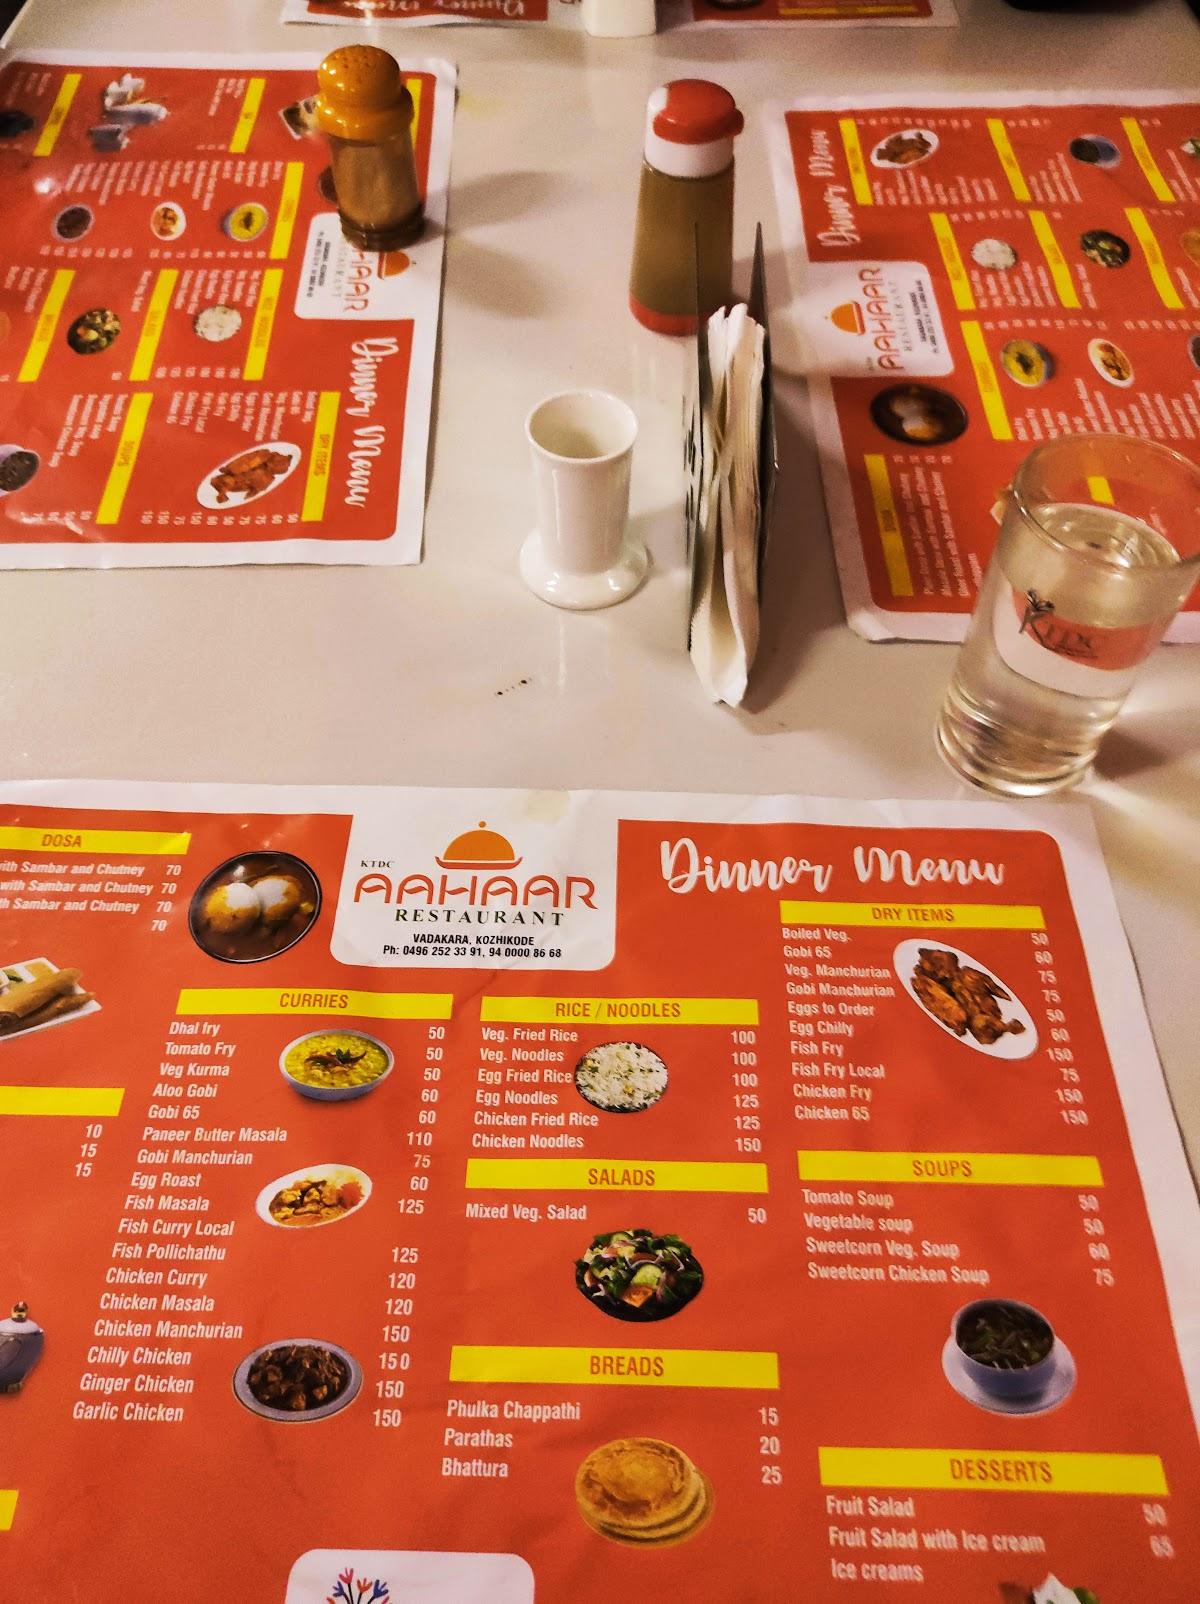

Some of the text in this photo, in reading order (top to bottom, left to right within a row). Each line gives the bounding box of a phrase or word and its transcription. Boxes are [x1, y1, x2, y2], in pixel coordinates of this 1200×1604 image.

[859, 267, 904, 370] AAHAAR
[344, 337, 399, 508] Dinner Menu
[42, 834, 81, 847] DOSA
[21, 862, 181, 877] Sambar and Chutney 70
[360, 860, 395, 868] KTDC
[661, 838, 1003, 893] Dinner Menu
[354, 874, 598, 909] AAHAAR
[396, 909, 564, 925] RESTAURANT
[872, 908, 954, 922] DRY ITEMS
[476, 935, 534, 946] KOZHIKODE
[782, 928, 850, 942] Boiled Veg.
[403, 946, 427, 956] 0496
[432, 947, 449, 956] 252
[454, 947, 466, 957] 33
[489, 948, 501, 957] 94
[505, 948, 530, 958] 0000
[534, 948, 545, 958] 86
[549, 949, 561, 958] 68
[784, 946, 832, 959] Gobi 65
[785, 964, 891, 978] Veg. Manchurian
[787, 982, 895, 997] Gobi Manchurian
[280, 993, 348, 1008] CURRIES
[788, 1001, 874, 1016] Eggs to Order
[556, 1003, 680, 1017] RICE NOODLES
[169, 1022, 220, 1037] Dhal fry
[482, 1028, 577, 1042] Veg. Fried Rice
[790, 1020, 854, 1037] Egg Chilly
[166, 1042, 236, 1057] Tomato Fry
[480, 1048, 564, 1063] Veg. Noodles
[791, 1041, 843, 1057] Fish Fry
[160, 1063, 229, 1078] Veg Kurma
[478, 1069, 572, 1084] Egg Fried Rice
[792, 1062, 885, 1079] Fish Fry Local
[153, 1083, 218, 1097] Aloo Gobi
[476, 1089, 558, 1106] Egg Noodles
[793, 1083, 872, 1102] Chicken Fry
[148, 1105, 200, 1119] Gobi 65
[474, 1111, 598, 1126] Chicken Fried Rice
[795, 1105, 870, 1121] Chicken 65
[86, 1124, 102, 1138] 10
[143, 1127, 287, 1141] Paneer Butter Masala
[472, 1133, 584, 1148] Chicken Noodles
[81, 1144, 97, 1157] 15
[137, 1149, 252, 1164] Gobi Manchurian
[76, 1163, 92, 1177] 15
[589, 1168, 655, 1186] SALADS
[912, 1160, 972, 1178] SOUPS
[131, 1172, 201, 1189] Egg Roast
[125, 1195, 209, 1210] Fish Masala
[802, 1189, 894, 1209] Tomato Soup
[466, 1203, 767, 1223] Mixed Veg. Salad 50
[118, 1218, 234, 1238] Fish Curry Local
[804, 1213, 913, 1234] Vegetable soup
[112, 1243, 226, 1260] Fish Pollichathu
[806, 1237, 960, 1260] Sweetcorn Veg. Soup
[106, 1267, 207, 1288] Chicken Curry
[808, 1262, 989, 1285] Sweetcorn Chicken Soup
[100, 1293, 214, 1311] Chicken Masala
[95, 1319, 242, 1338] Chicken Manchurian
[88, 1346, 191, 1367] Chilly Chicken
[591, 1356, 664, 1377] BREADS
[80, 1373, 193, 1394] Ginger Chicken
[73, 1401, 184, 1421] Garlic Chicken
[447, 1400, 778, 1425] Phulka Chappathi 15
[444, 1428, 780, 1455] Parathas 20
[442, 1458, 782, 1484] Bhattura 25
[950, 1459, 1052, 1483] DESSERTS
[827, 1495, 915, 1517] Fruit Salad
[829, 1526, 1045, 1552] Fruit Salad with Ice cream
[832, 1558, 924, 1581] Ice creams
